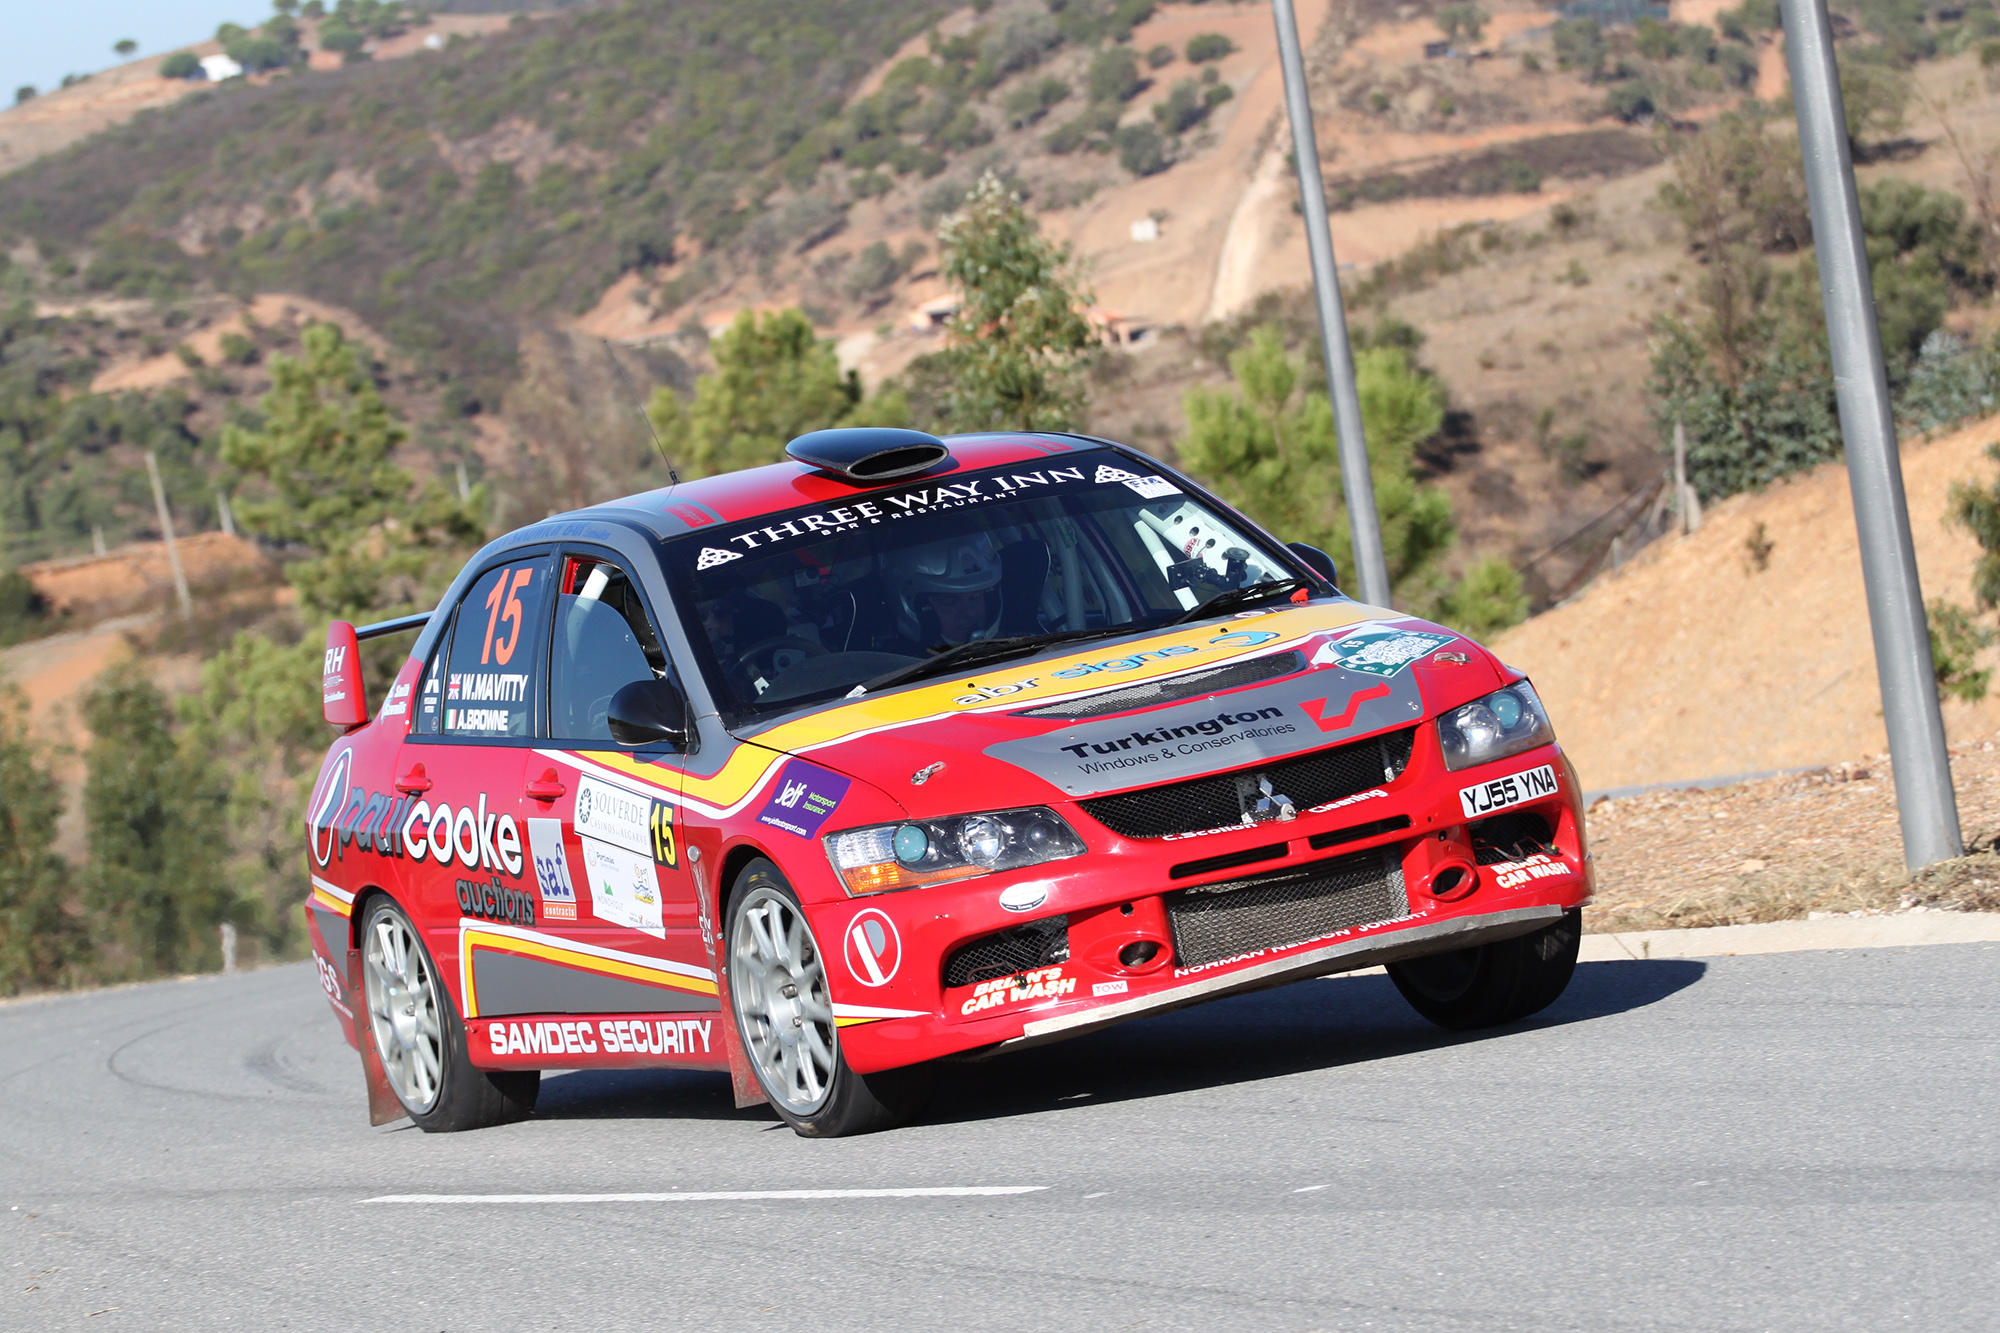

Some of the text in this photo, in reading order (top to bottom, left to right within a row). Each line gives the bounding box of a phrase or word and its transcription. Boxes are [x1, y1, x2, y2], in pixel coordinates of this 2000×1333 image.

[730, 501, 883, 550] THREE
[884, 480, 985, 510] WAY
[991, 466, 1086, 491] INN
[820, 490, 1018, 536] BAR & RESTAURANT
[480, 567, 534, 666] 15
[323, 645, 346, 676] RH
[951, 677, 1041, 706] abr
[1050, 645, 1199, 680] signs
[462, 674, 529, 702] W.MAVITTY
[457, 709, 509, 732] A.BROWNE
[1060, 705, 1284, 759] Turkington
[1077, 722, 1296, 775] Windows & Conservatories
[594, 791, 644, 827] SOLVERDE
[774, 779, 808, 809] Jelf
[808, 791, 837, 808] Motorsport
[1463, 767, 1557, 814] YJ55 YNA
[590, 816, 616, 834] CASINOS
[621, 829, 648, 846] ALGARVE
[1162, 788, 1389, 842] C.Scollon Cleaning
[650, 802, 677, 866] 15
[1496, 862, 1572, 889] CAR WASH
[455, 876, 536, 926] auctions
[545, 906, 575, 917] contracts
[1173, 949, 1265, 978] NORMAN
[1271, 928, 1351, 953] NELSON
[961, 978, 1077, 1015] CAR WASH
[1094, 981, 1124, 994] TOW
[489, 1020, 712, 1055] SAMDEC SECURITY
